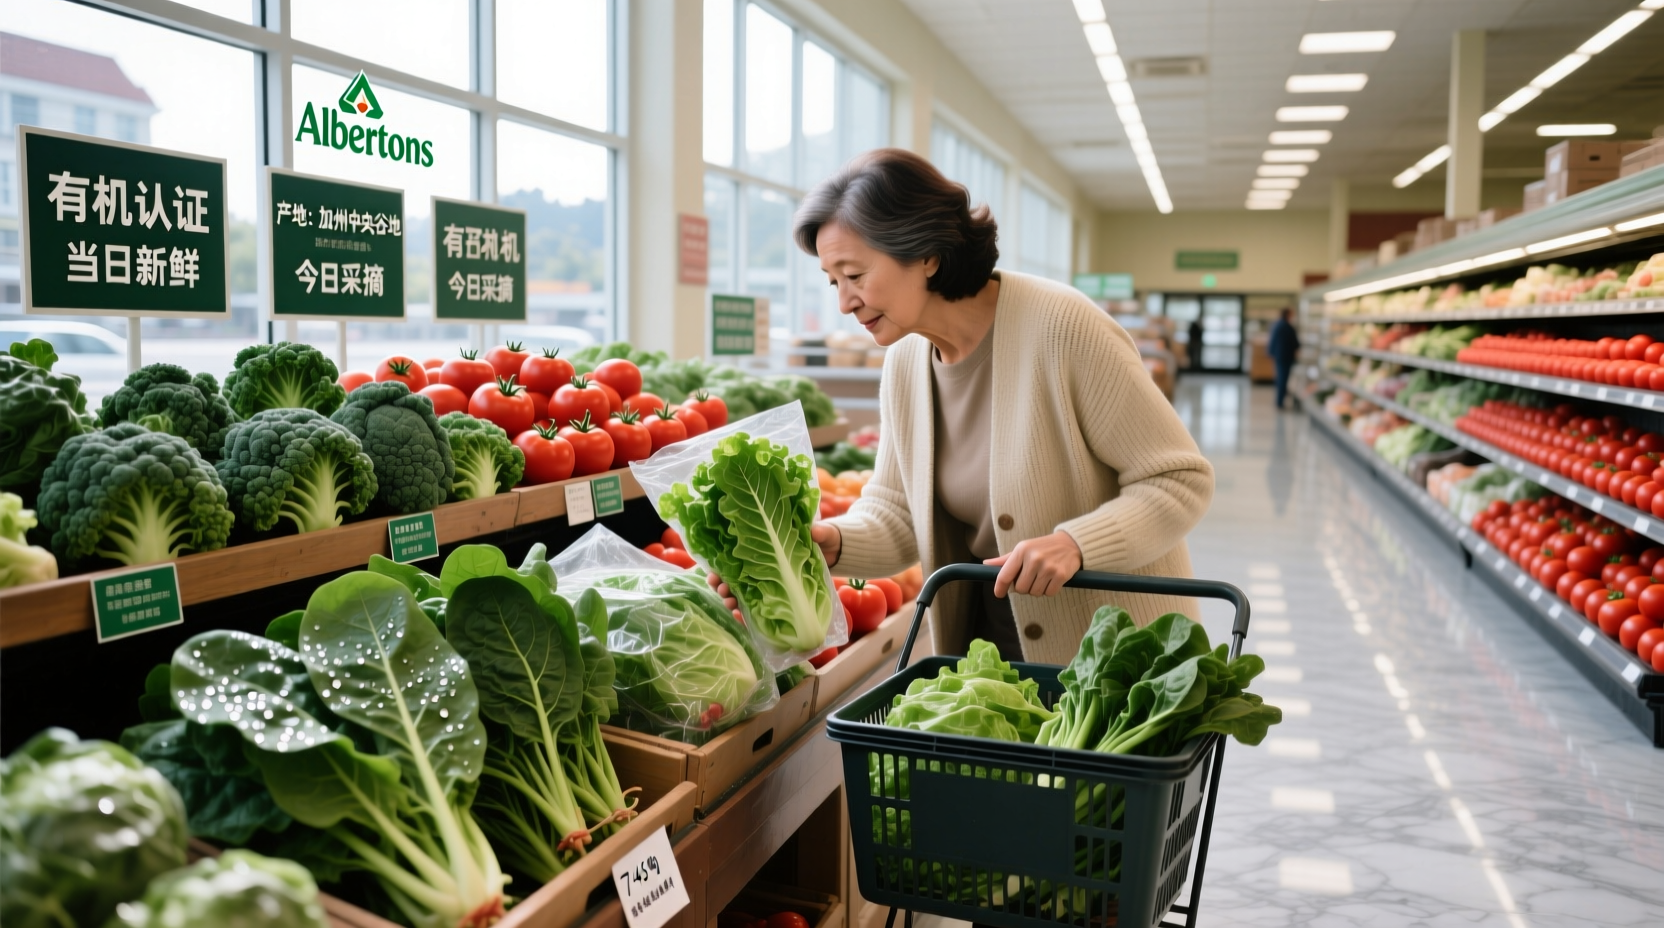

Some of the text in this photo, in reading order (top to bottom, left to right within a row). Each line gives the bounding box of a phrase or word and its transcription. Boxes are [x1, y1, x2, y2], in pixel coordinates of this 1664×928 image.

[295, 101, 434, 167] Albertons
[47, 170, 210, 234] 有机认证
[67, 240, 200, 289] 当日新鲜
[295, 258, 384, 297] 今日采摘
